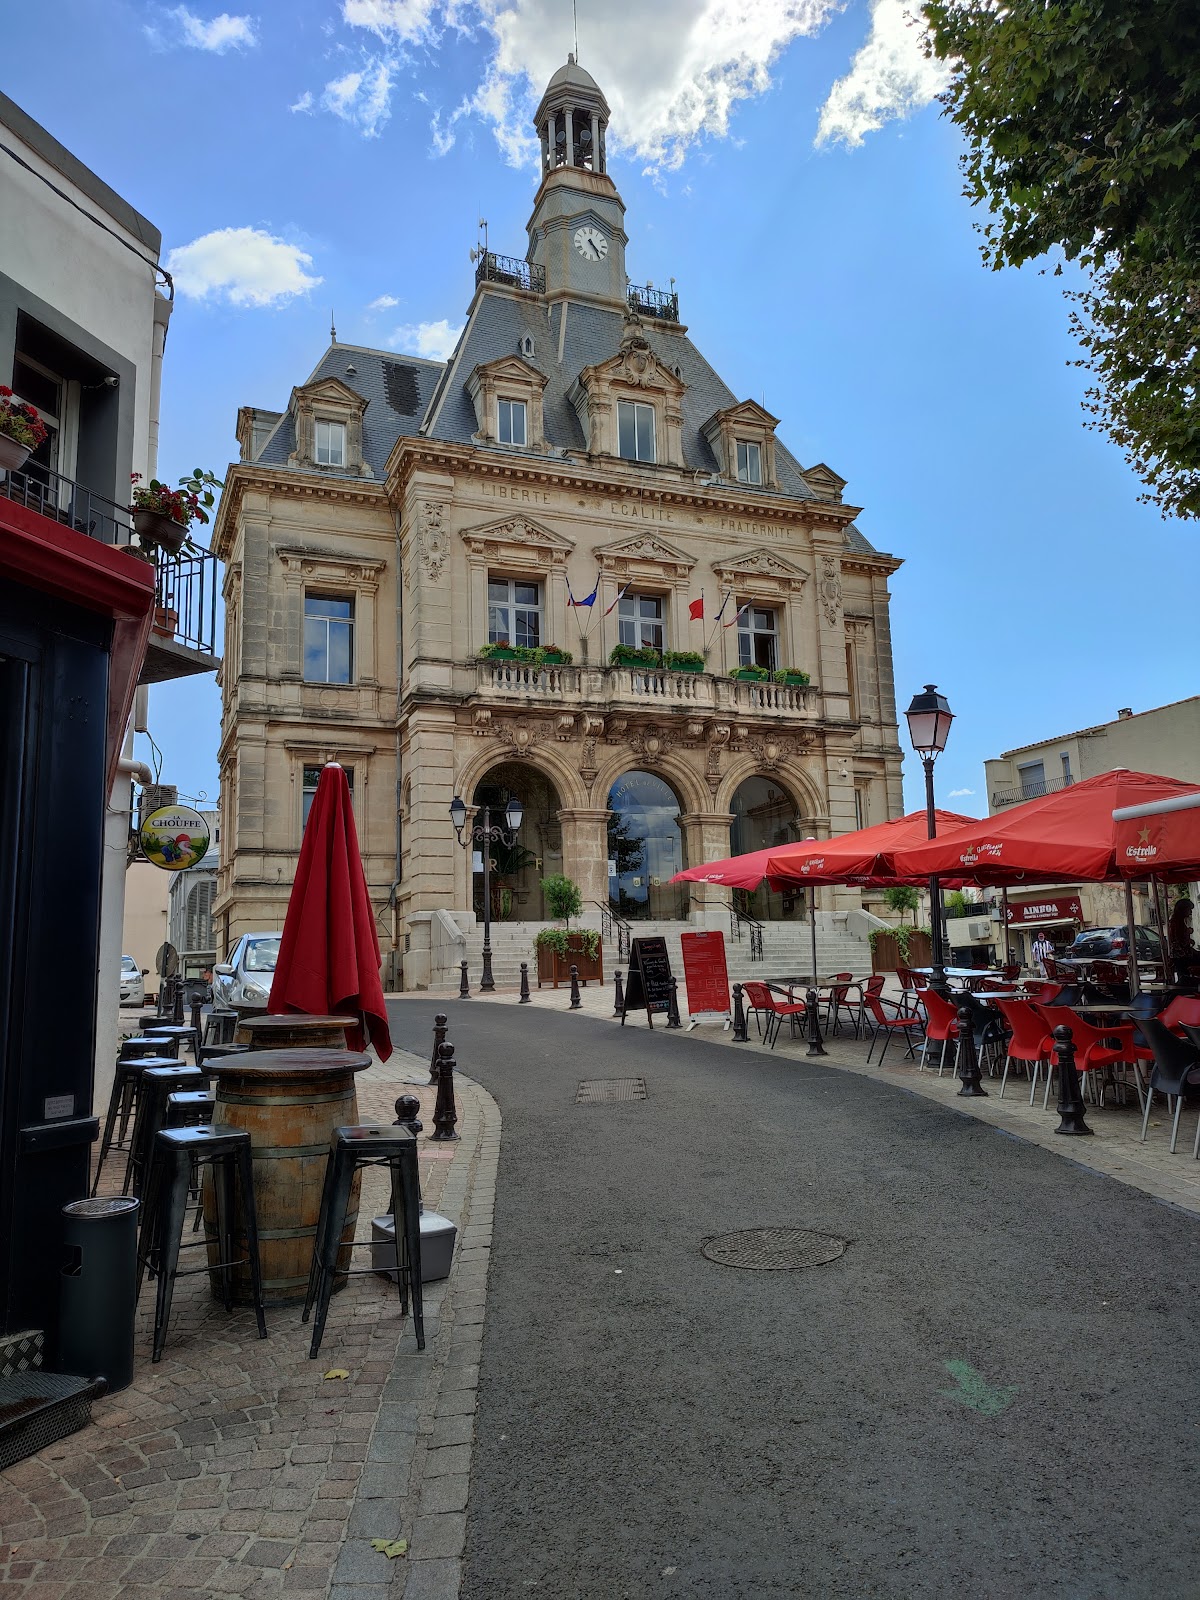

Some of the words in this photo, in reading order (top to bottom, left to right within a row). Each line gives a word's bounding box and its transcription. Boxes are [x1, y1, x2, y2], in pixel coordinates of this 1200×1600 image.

[481, 483, 551, 505] LIBERTE
[721, 518, 793, 539] FRATERNITE
[151, 819, 201, 828] CHOUFFE
[1125, 845, 1157, 857] Estrella
[959, 853, 979, 863] Estrella
[488, 858, 499, 873] R
[534, 857, 543, 871] F
